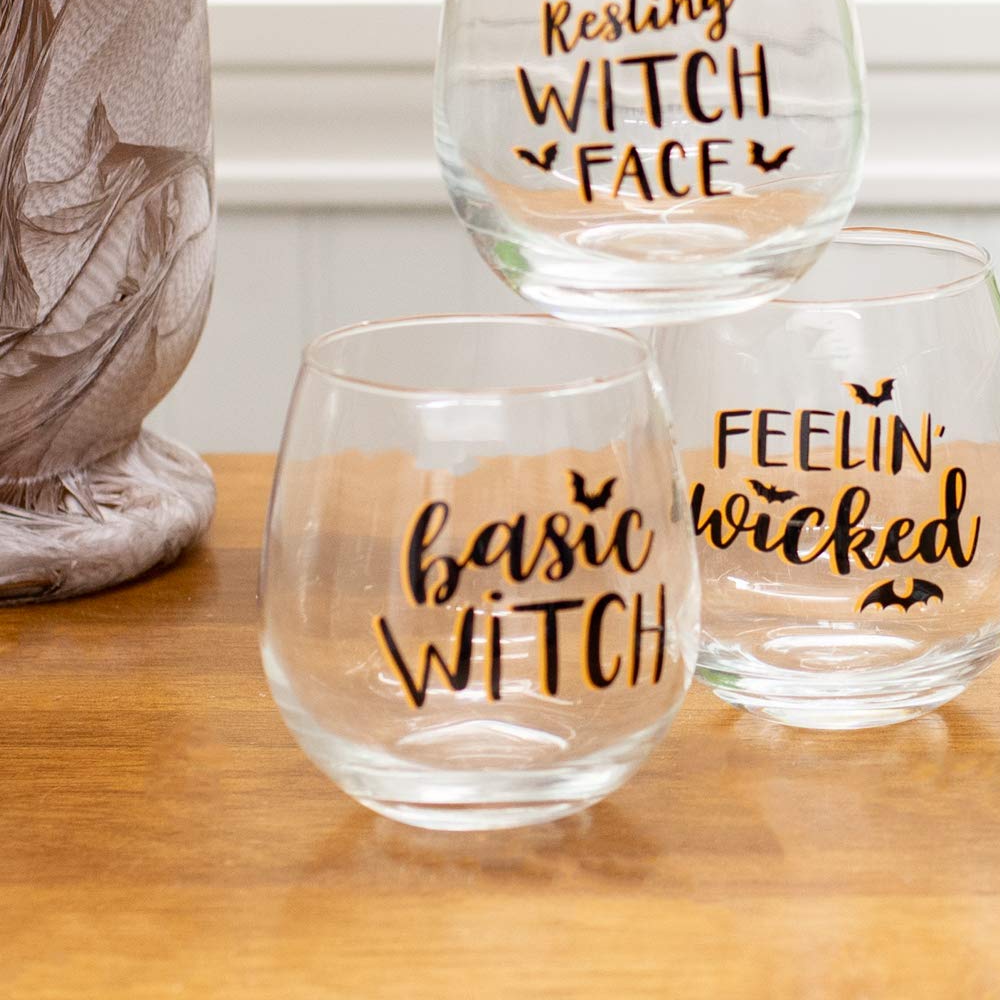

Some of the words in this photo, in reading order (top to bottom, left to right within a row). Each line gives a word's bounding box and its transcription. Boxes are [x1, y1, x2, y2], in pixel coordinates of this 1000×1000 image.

[515, 42, 770, 133] WITCH
[574, 138, 732, 204] FACE
[712, 407, 946, 475] FEELIN'
[400, 500, 654, 607] basic
[689, 465, 981, 575] wicked
